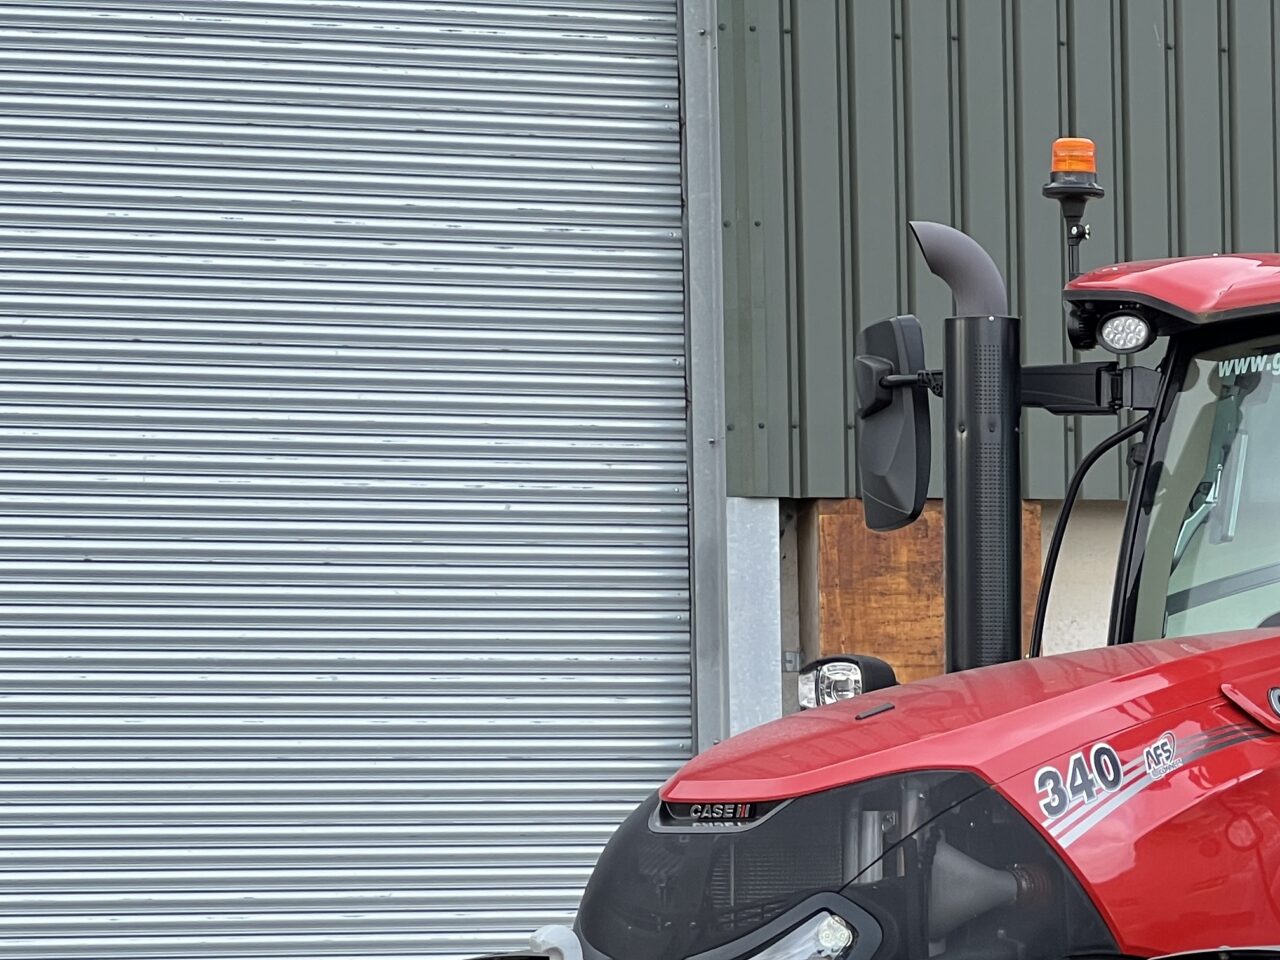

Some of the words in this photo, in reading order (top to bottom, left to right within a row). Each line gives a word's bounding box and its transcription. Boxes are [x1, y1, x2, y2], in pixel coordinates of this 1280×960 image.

[1034, 742, 1124, 819] 340
[1144, 738, 1173, 773] AFS
[690, 804, 735, 818] CASE
